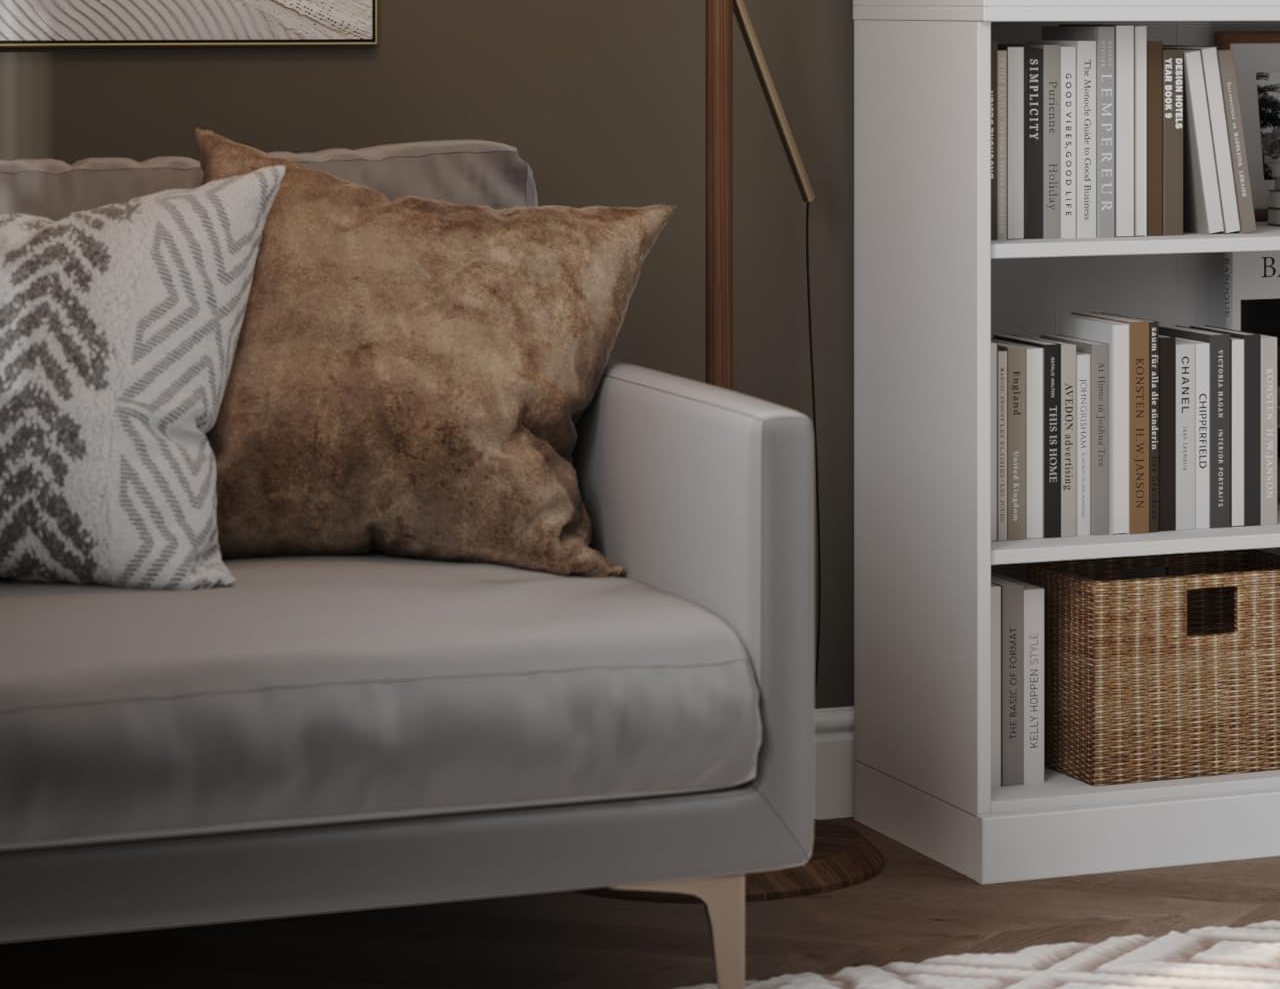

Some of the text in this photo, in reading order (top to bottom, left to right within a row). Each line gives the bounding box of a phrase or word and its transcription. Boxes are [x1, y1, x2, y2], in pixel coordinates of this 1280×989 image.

[1029, 59, 1039, 140] SIMPLICITY
[1165, 58, 1173, 82] YEAR
[1165, 85, 1173, 111] BOOK
[1175, 58, 1183, 130] DESIGN HOTELS
[1047, 81, 1058, 211] Purienne Holiday
[1083, 60, 1092, 221] The Monocle Guide to Good Business
[1101, 74, 1113, 212] LEMPEREUR
[1080, 379, 1088, 405] JOHN
[1136, 358, 1145, 419] KONSTEN
[1180, 356, 1190, 413] CHANEL
[1049, 405, 1058, 484] THIS IS HOME
[1063, 382, 1074, 492] AVEDON advertising
[1080, 406, 1088, 449] GRISHAM
[1198, 393, 1207, 469] CHIPPERFIELD
[1009, 627, 1017, 739] THE BASIC OF FORMAT
[1029, 634, 1039, 749] KELLY HOPPEN STYLE
